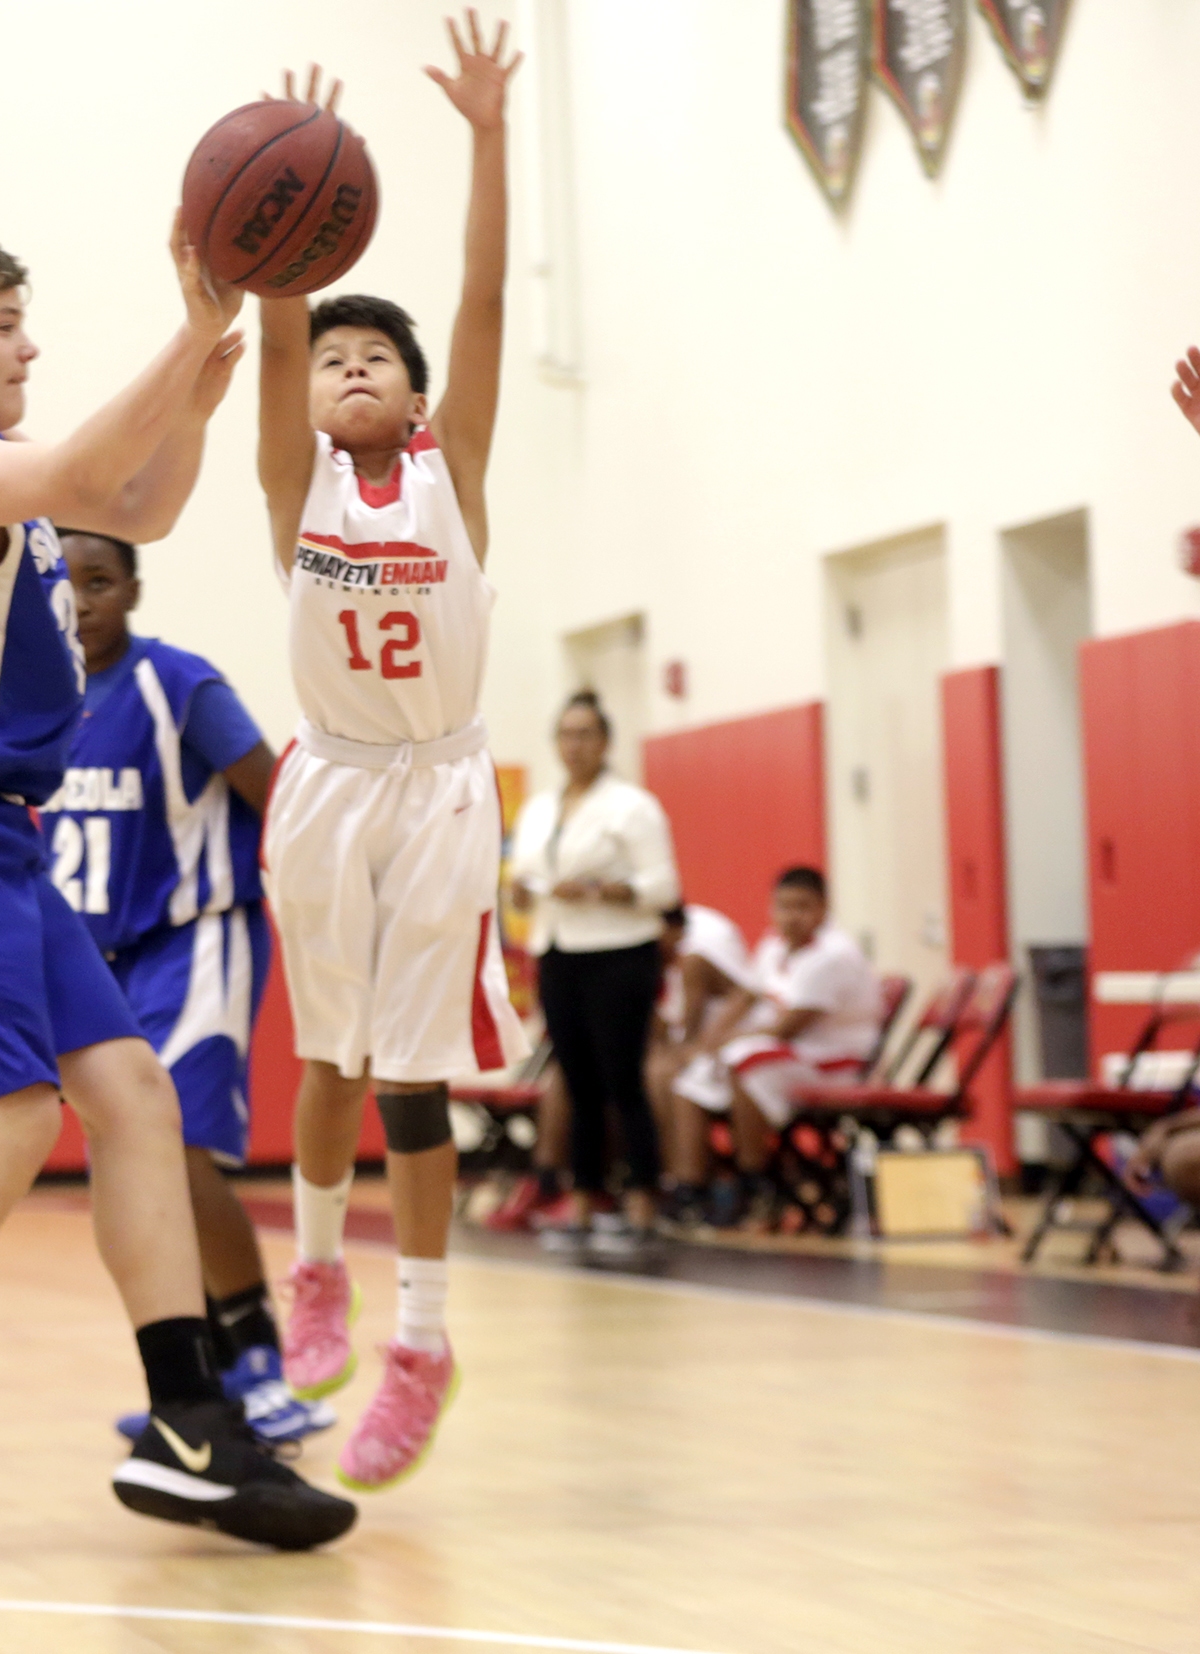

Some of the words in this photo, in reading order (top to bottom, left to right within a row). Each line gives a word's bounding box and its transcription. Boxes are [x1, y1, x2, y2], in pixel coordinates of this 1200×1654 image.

[232, 165, 306, 255] NCAA
[338, 609, 423, 680] 12
[51, 815, 112, 914] 21
